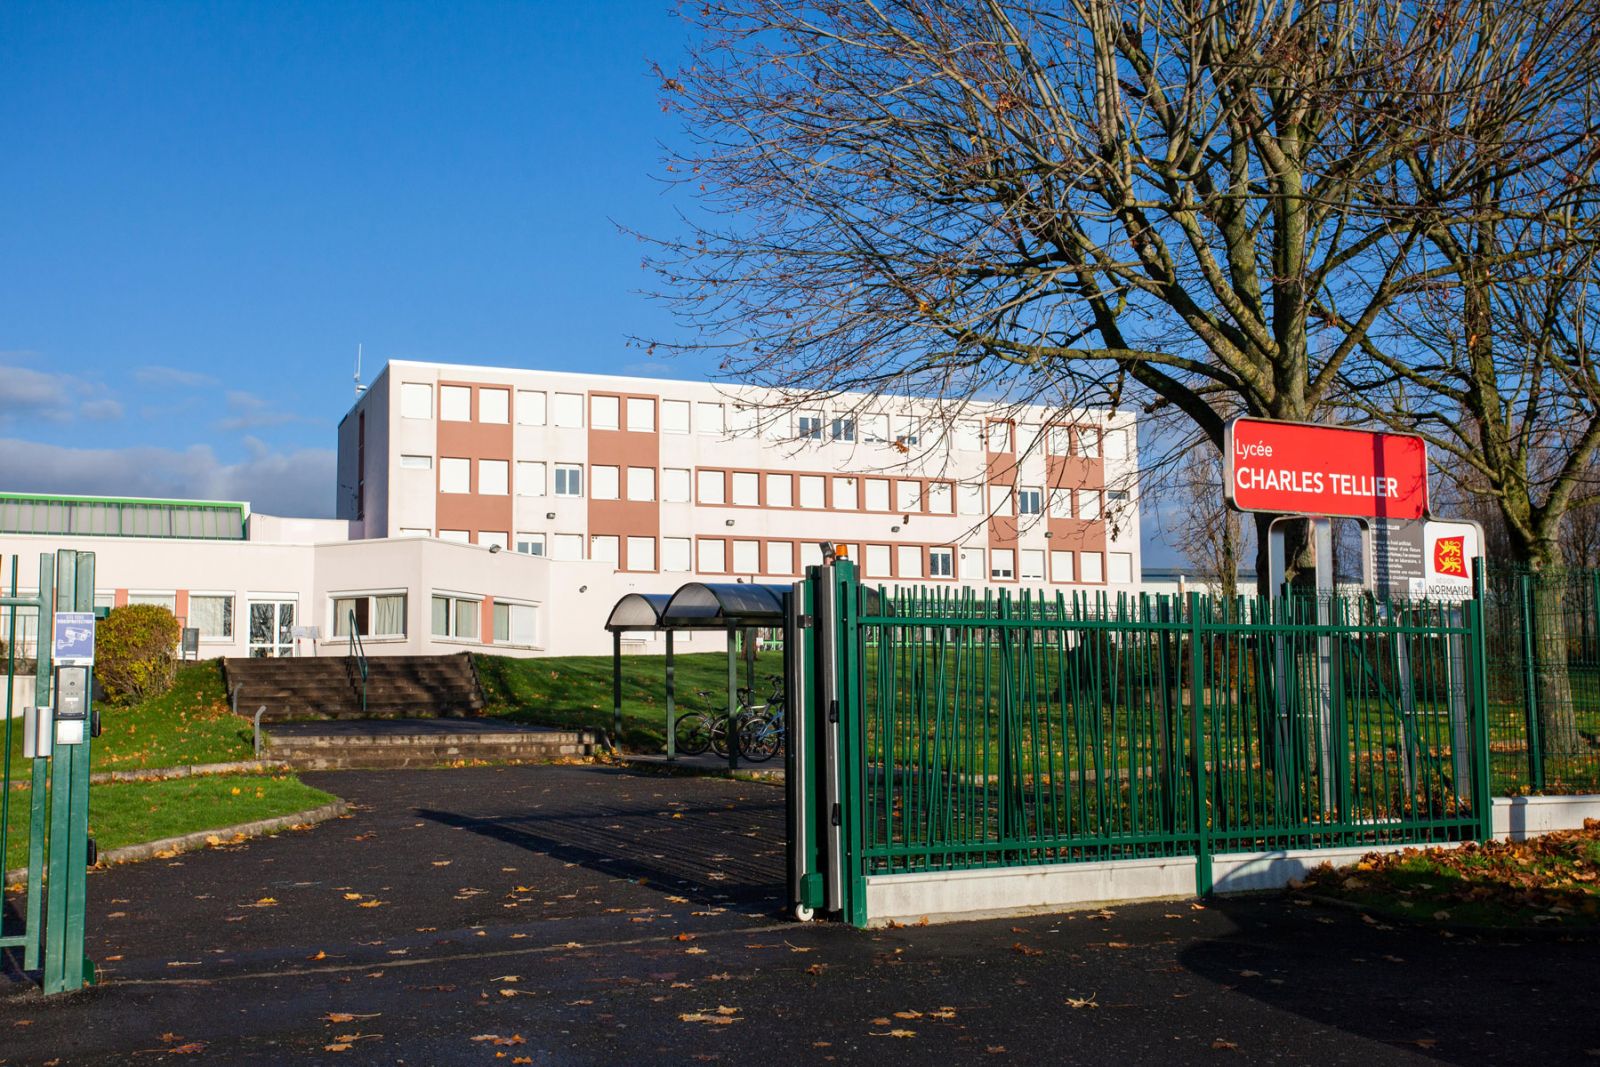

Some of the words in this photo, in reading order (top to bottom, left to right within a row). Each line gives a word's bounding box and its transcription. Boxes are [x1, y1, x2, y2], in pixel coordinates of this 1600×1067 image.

[1236, 438, 1273, 460] Lycée
[1236, 467, 1324, 494] CHARLES
[1328, 473, 1399, 498] TELLIER
[1428, 584, 1472, 596] NORMANDI
